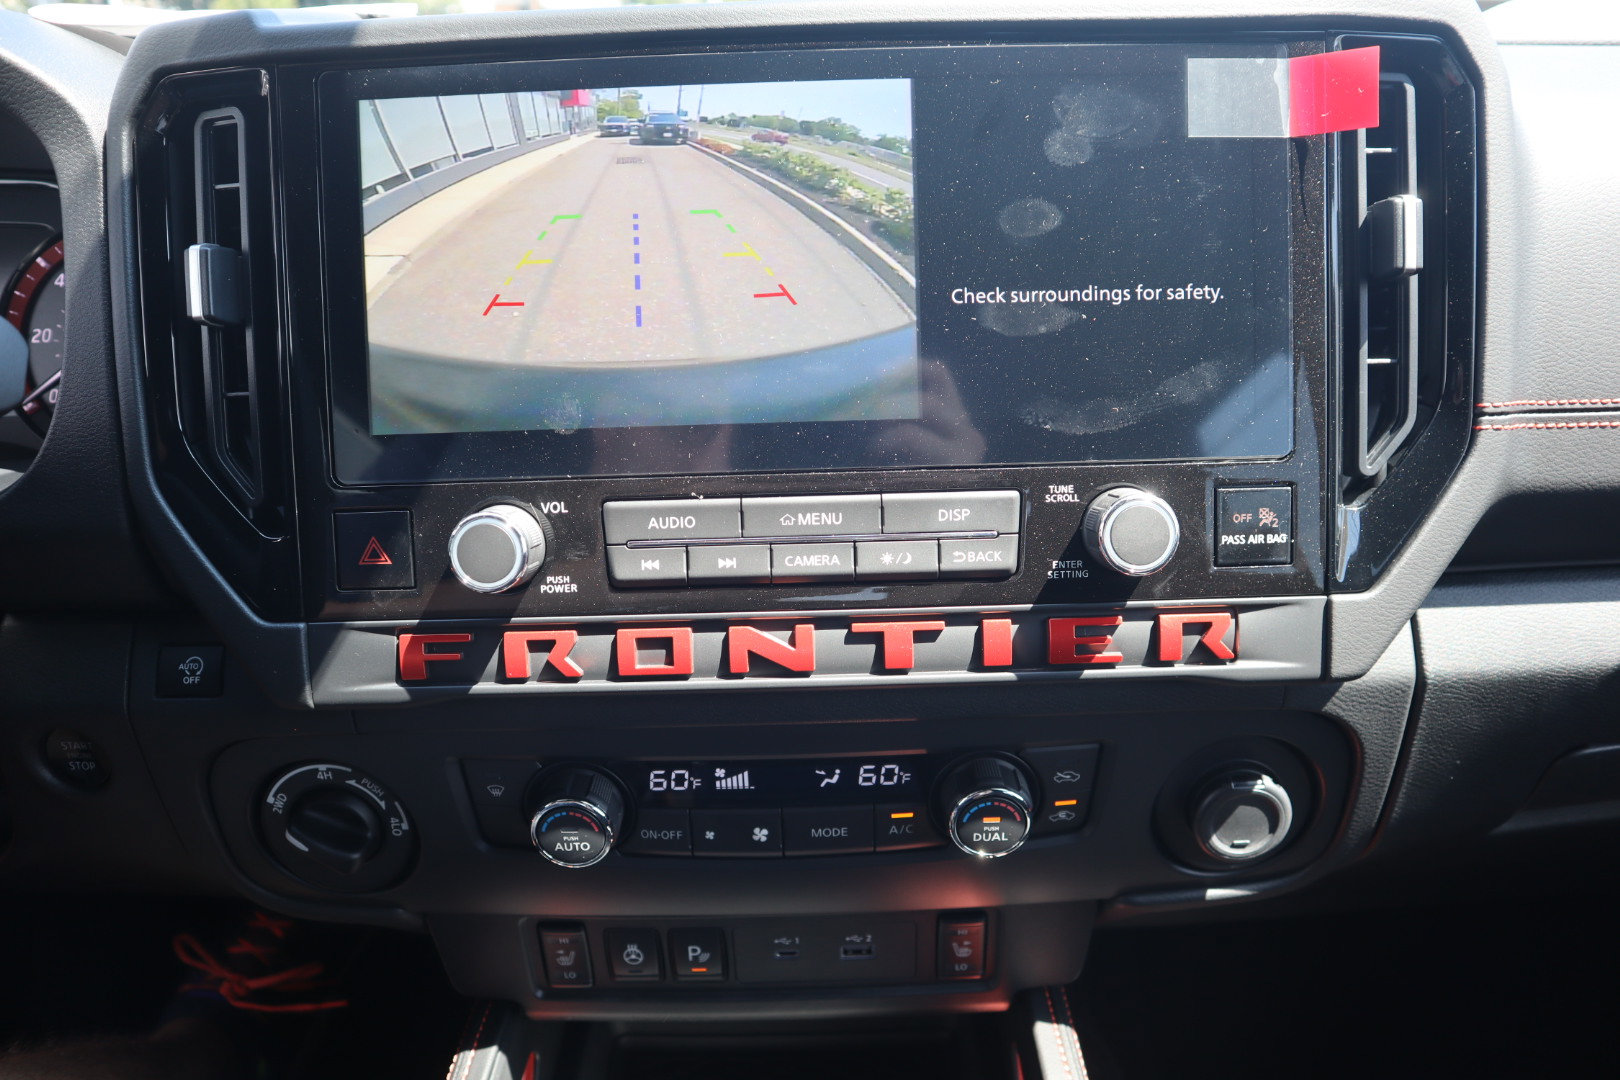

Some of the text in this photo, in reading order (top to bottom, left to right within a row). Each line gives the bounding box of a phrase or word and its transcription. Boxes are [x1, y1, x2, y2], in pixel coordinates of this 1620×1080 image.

[54, 273, 65, 287] 4
[951, 283, 1225, 305] Check surroundings for safety.
[31, 328, 51, 343] 20
[48, 389, 59, 404] 0
[1048, 485, 1075, 493] TUNE
[1045, 494, 1080, 502] SCROLL
[540, 502, 568, 514] VOL
[798, 512, 842, 526] MENU
[938, 508, 971, 522] DISP
[1232, 513, 1253, 523] OFF
[648, 516, 696, 530] AUDIO
[1221, 534, 1288, 545] PASS AIR BAG
[784, 554, 841, 567] CAMERA
[968, 550, 1002, 563] BACK
[1052, 559, 1083, 569] ENTER
[546, 576, 570, 584] PUSH
[1047, 569, 1089, 579] SETTING
[540, 584, 578, 594] POWER
[397, 611, 1237, 684] FRONTIER
[182, 676, 201, 685] OFF
[60, 741, 93, 751] START
[69, 760, 96, 771] STOP
[316, 770, 333, 781] 4H
[360, 777, 385, 798] PUSH
[272, 792, 288, 815] 2WD
[390, 816, 402, 837] 4LO
[811, 826, 848, 838] MODE
[889, 824, 913, 835] A/C
[972, 831, 1009, 843] DUAL
[555, 841, 591, 853] AUTO
[865, 934, 873, 943] 2
[688, 945, 702, 962] P
[954, 963, 968, 971] LO
[563, 971, 576, 979] LO
